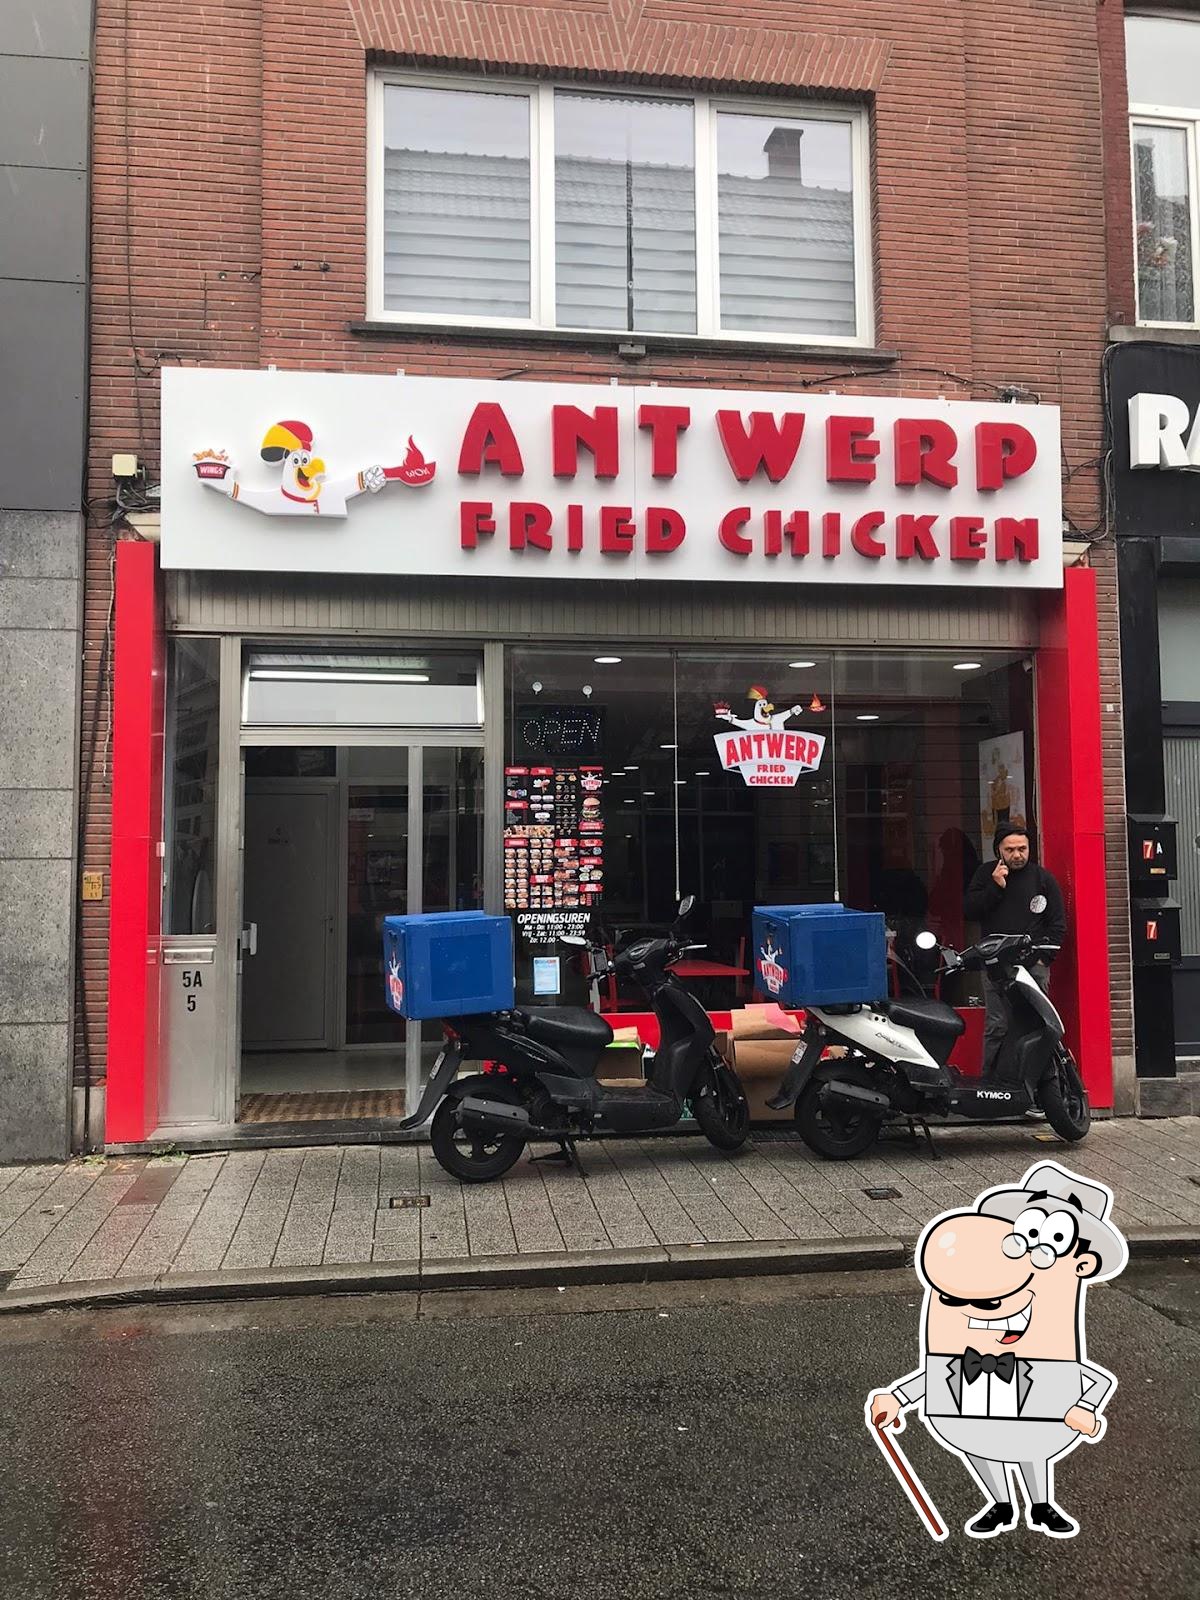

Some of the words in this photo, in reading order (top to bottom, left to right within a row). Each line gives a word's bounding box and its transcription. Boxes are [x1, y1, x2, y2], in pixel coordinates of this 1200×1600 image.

[458, 402, 1037, 491] ANTWERP
[200, 465, 224, 474] WINGS
[460, 501, 686, 554] FRIED
[718, 507, 1039, 562] CHICKEN
[523, 718, 601, 746] OPEN
[726, 733, 819, 766] ANTWERP
[757, 764, 786, 773] FRIED
[749, 776, 794, 785] CHICKEN
[1143, 840, 1153, 859] 7
[517, 912, 591, 924] OPENINGSUREN
[1147, 921, 1157, 939] 7
[182, 971, 202, 988] 5A
[187, 995, 196, 1012] 5
[976, 1090, 1011, 1100] KYMCO
